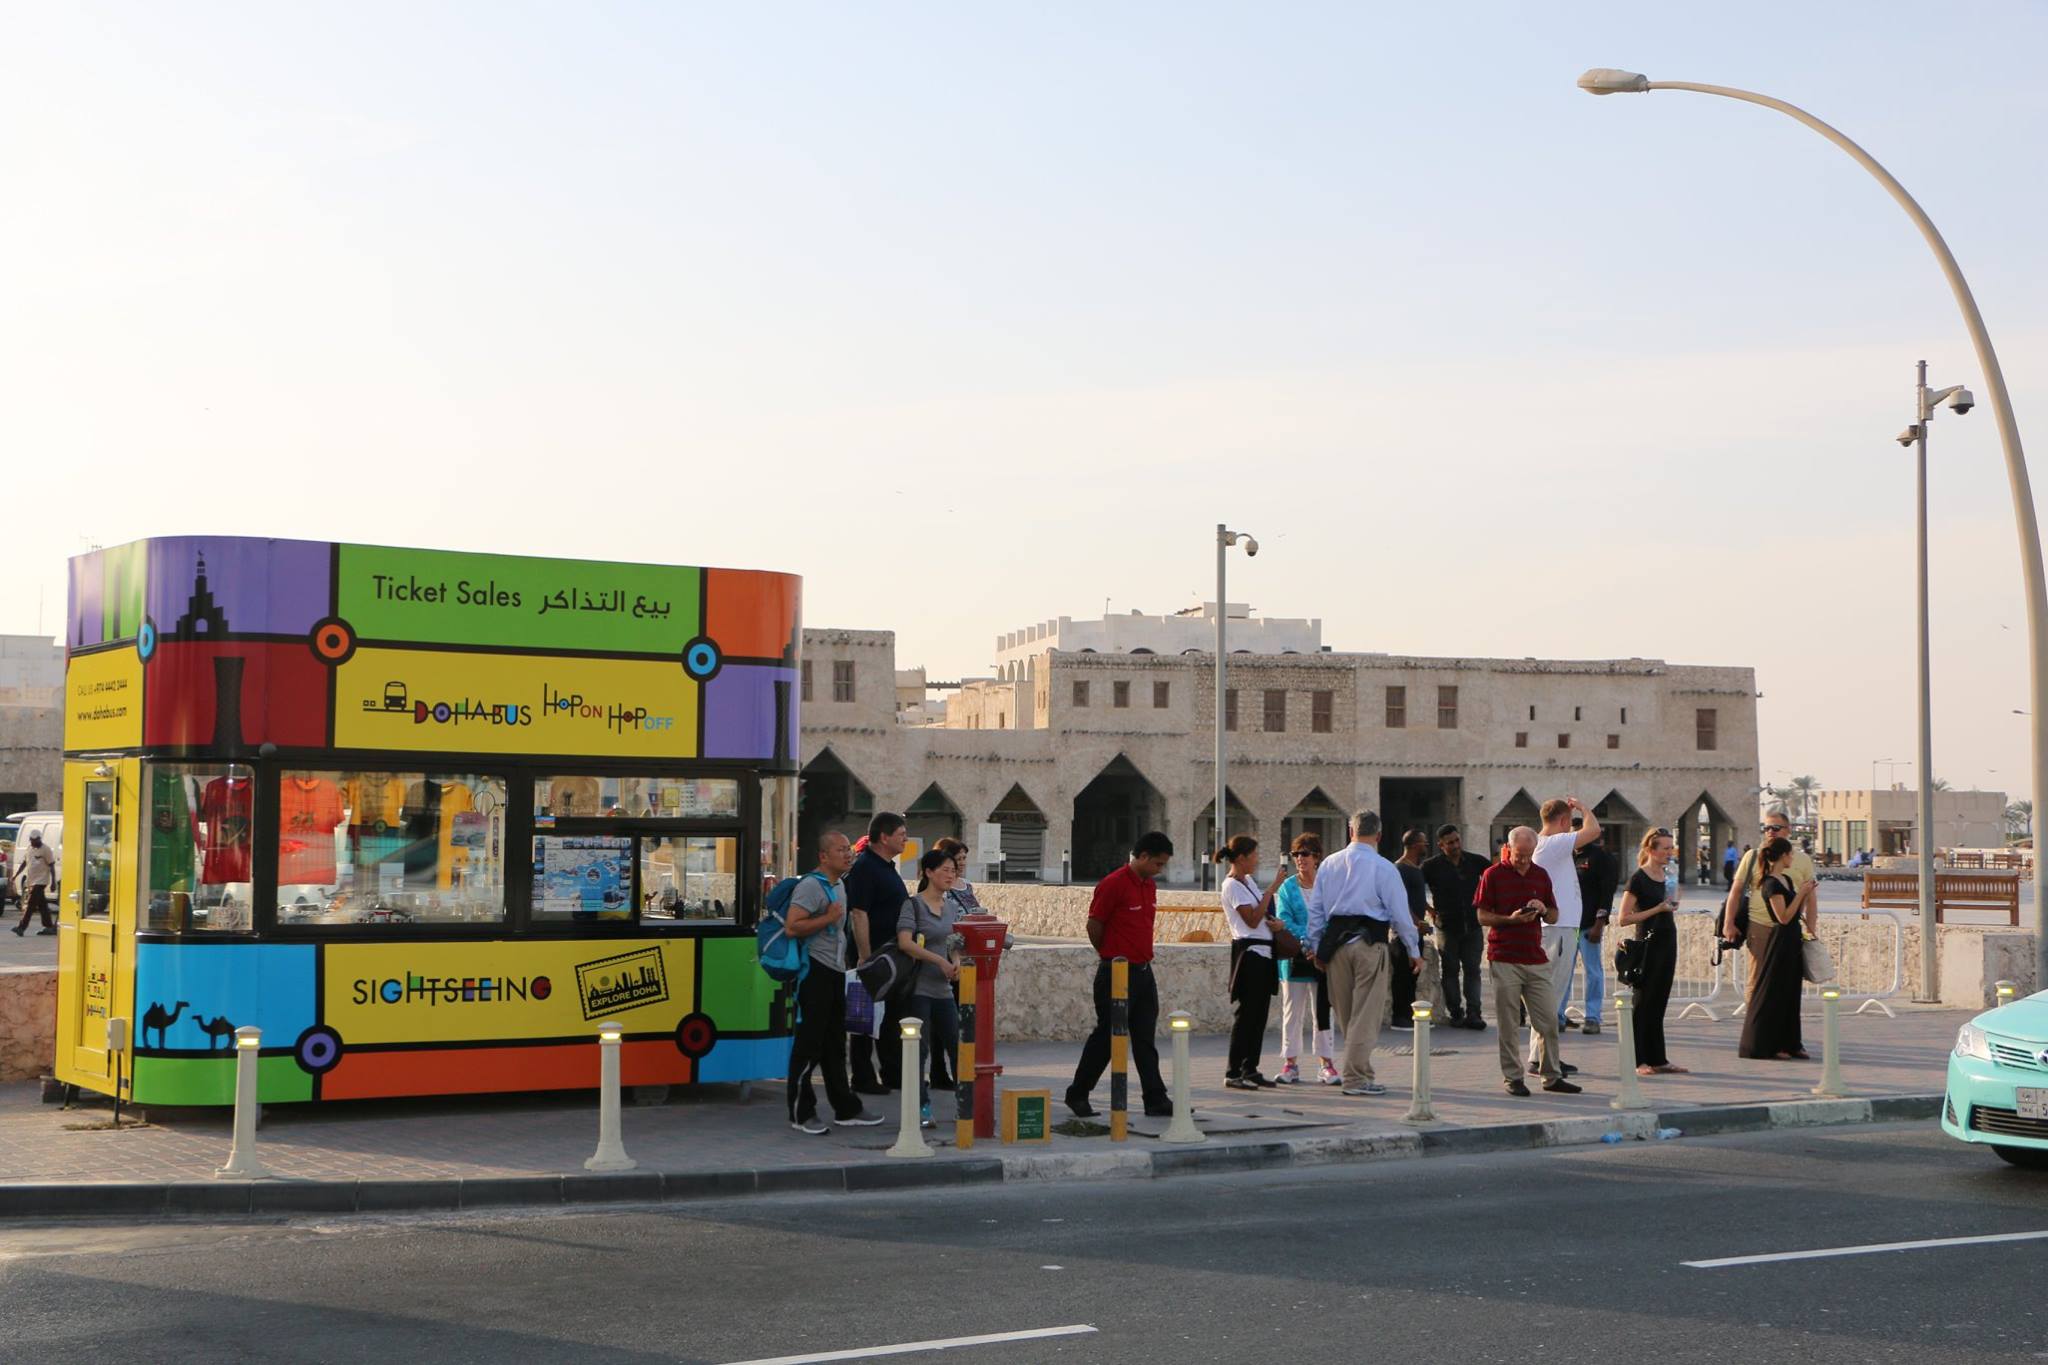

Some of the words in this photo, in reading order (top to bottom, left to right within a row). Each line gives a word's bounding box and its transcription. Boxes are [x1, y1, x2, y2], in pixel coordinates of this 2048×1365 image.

[373, 575, 447, 603] Ticket
[456, 580, 521, 608] Sales
[538, 587, 625, 615] التذاكر
[632, 595, 670, 619] بيع
[644, 716, 673, 730] OFF
[352, 970, 552, 1007] SIGHTSEEING
[591, 991, 631, 1008] EXPLORE
[632, 984, 658, 998] DOHA
